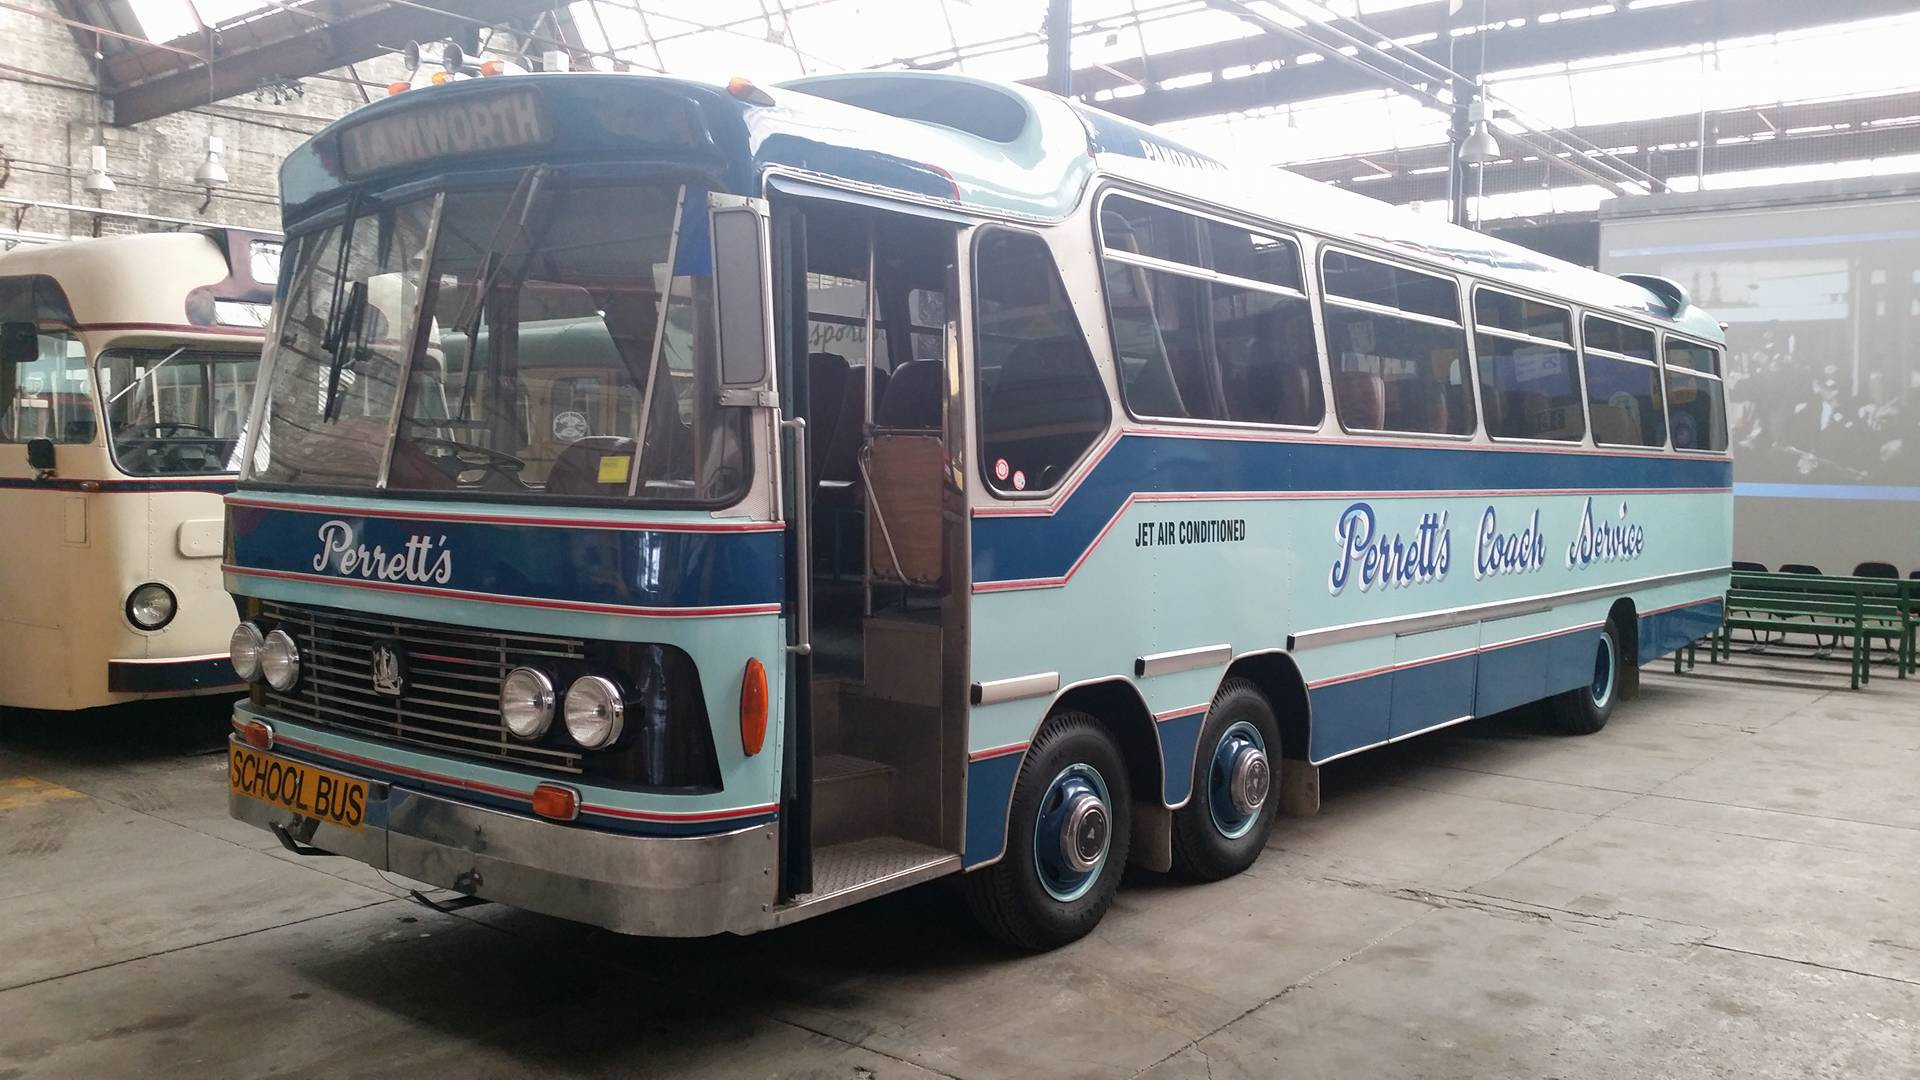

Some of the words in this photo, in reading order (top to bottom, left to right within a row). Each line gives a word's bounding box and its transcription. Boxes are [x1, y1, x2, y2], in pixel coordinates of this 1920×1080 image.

[312, 519, 453, 585] Perrett's
[1135, 522, 1155, 547] JET
[1157, 521, 1176, 546] AIR
[1179, 519, 1246, 545] CONDITIONED
[1329, 501, 1451, 597] Perrett's
[1474, 504, 1547, 582] Coach
[1565, 495, 1645, 572] Service
[231, 749, 308, 812] SCHOOL
[315, 774, 364, 827] BUS
